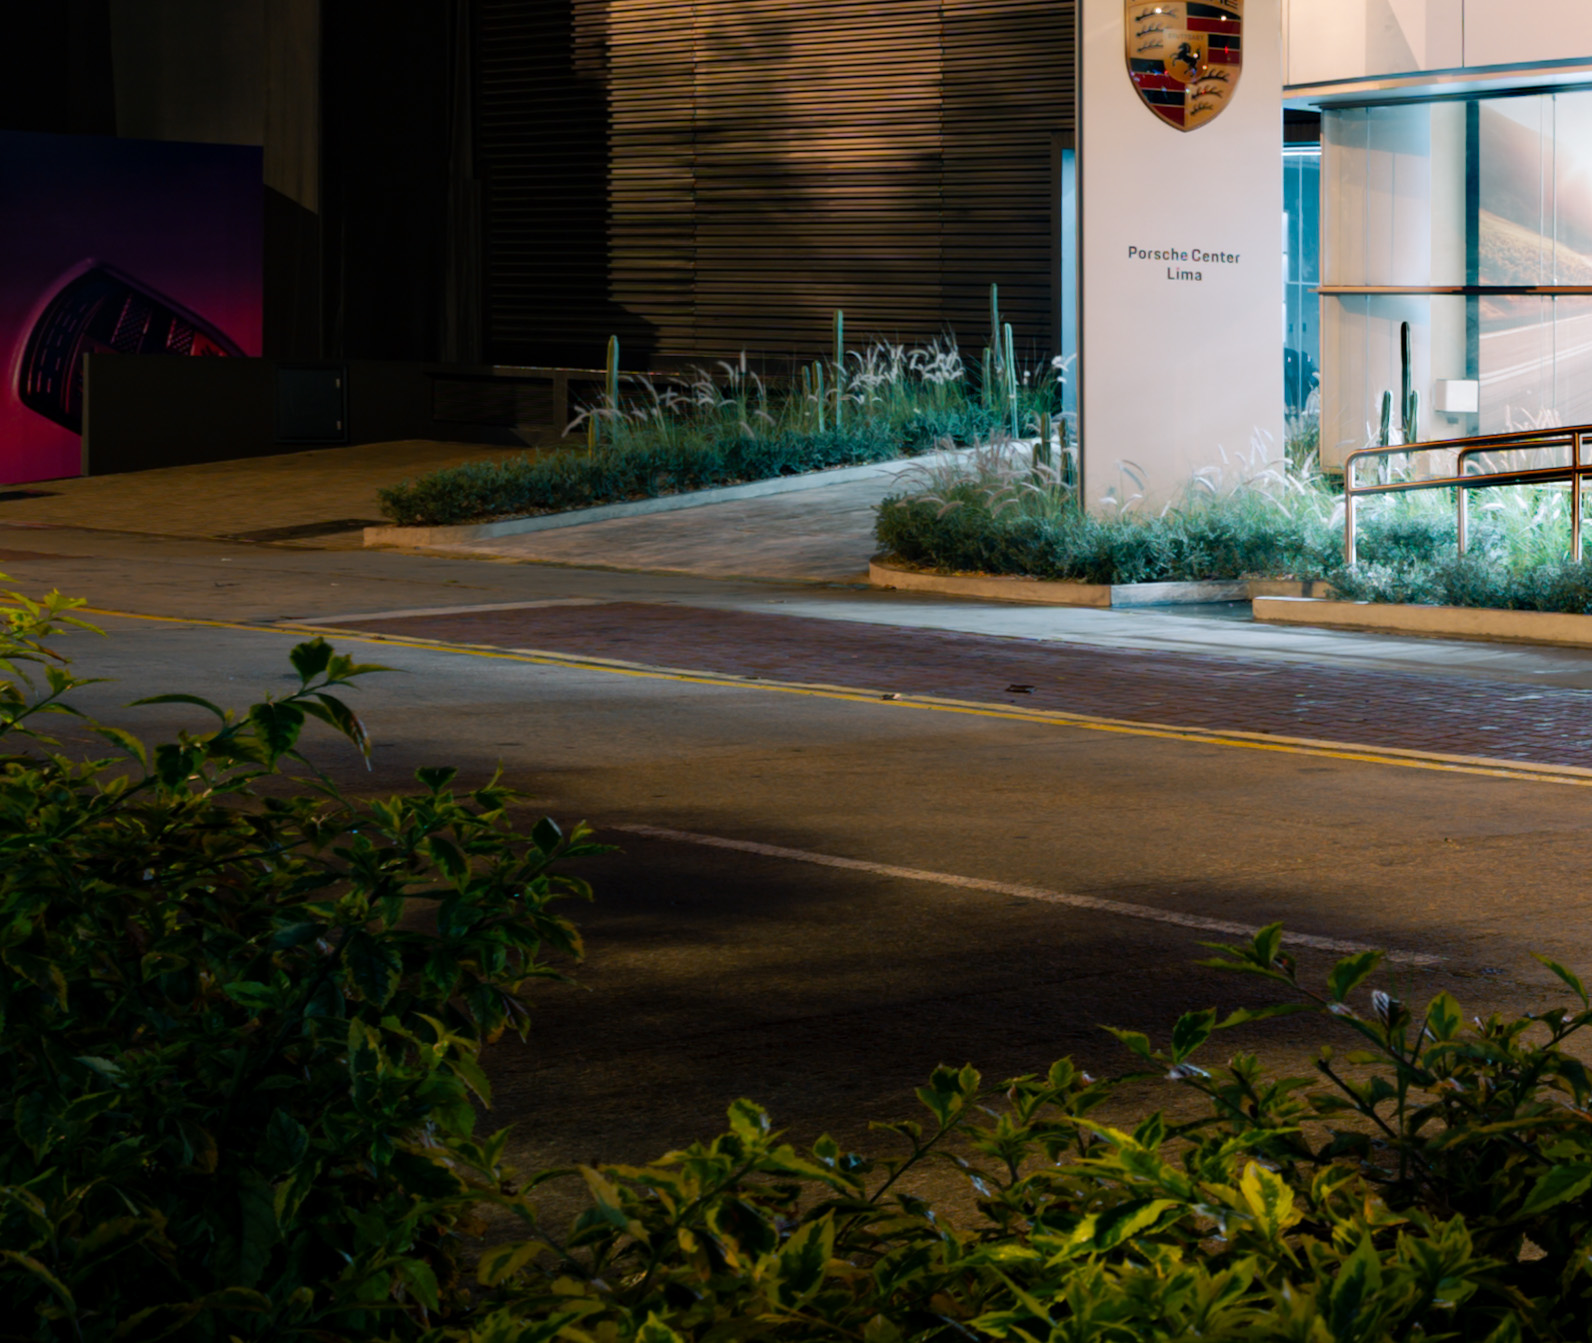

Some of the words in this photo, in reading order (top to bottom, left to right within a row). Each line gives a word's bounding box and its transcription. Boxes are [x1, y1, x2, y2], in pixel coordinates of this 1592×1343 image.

[1127, 245, 1189, 262] Porsche
[1191, 248, 1241, 264] Center
[1166, 266, 1203, 282] Lima
